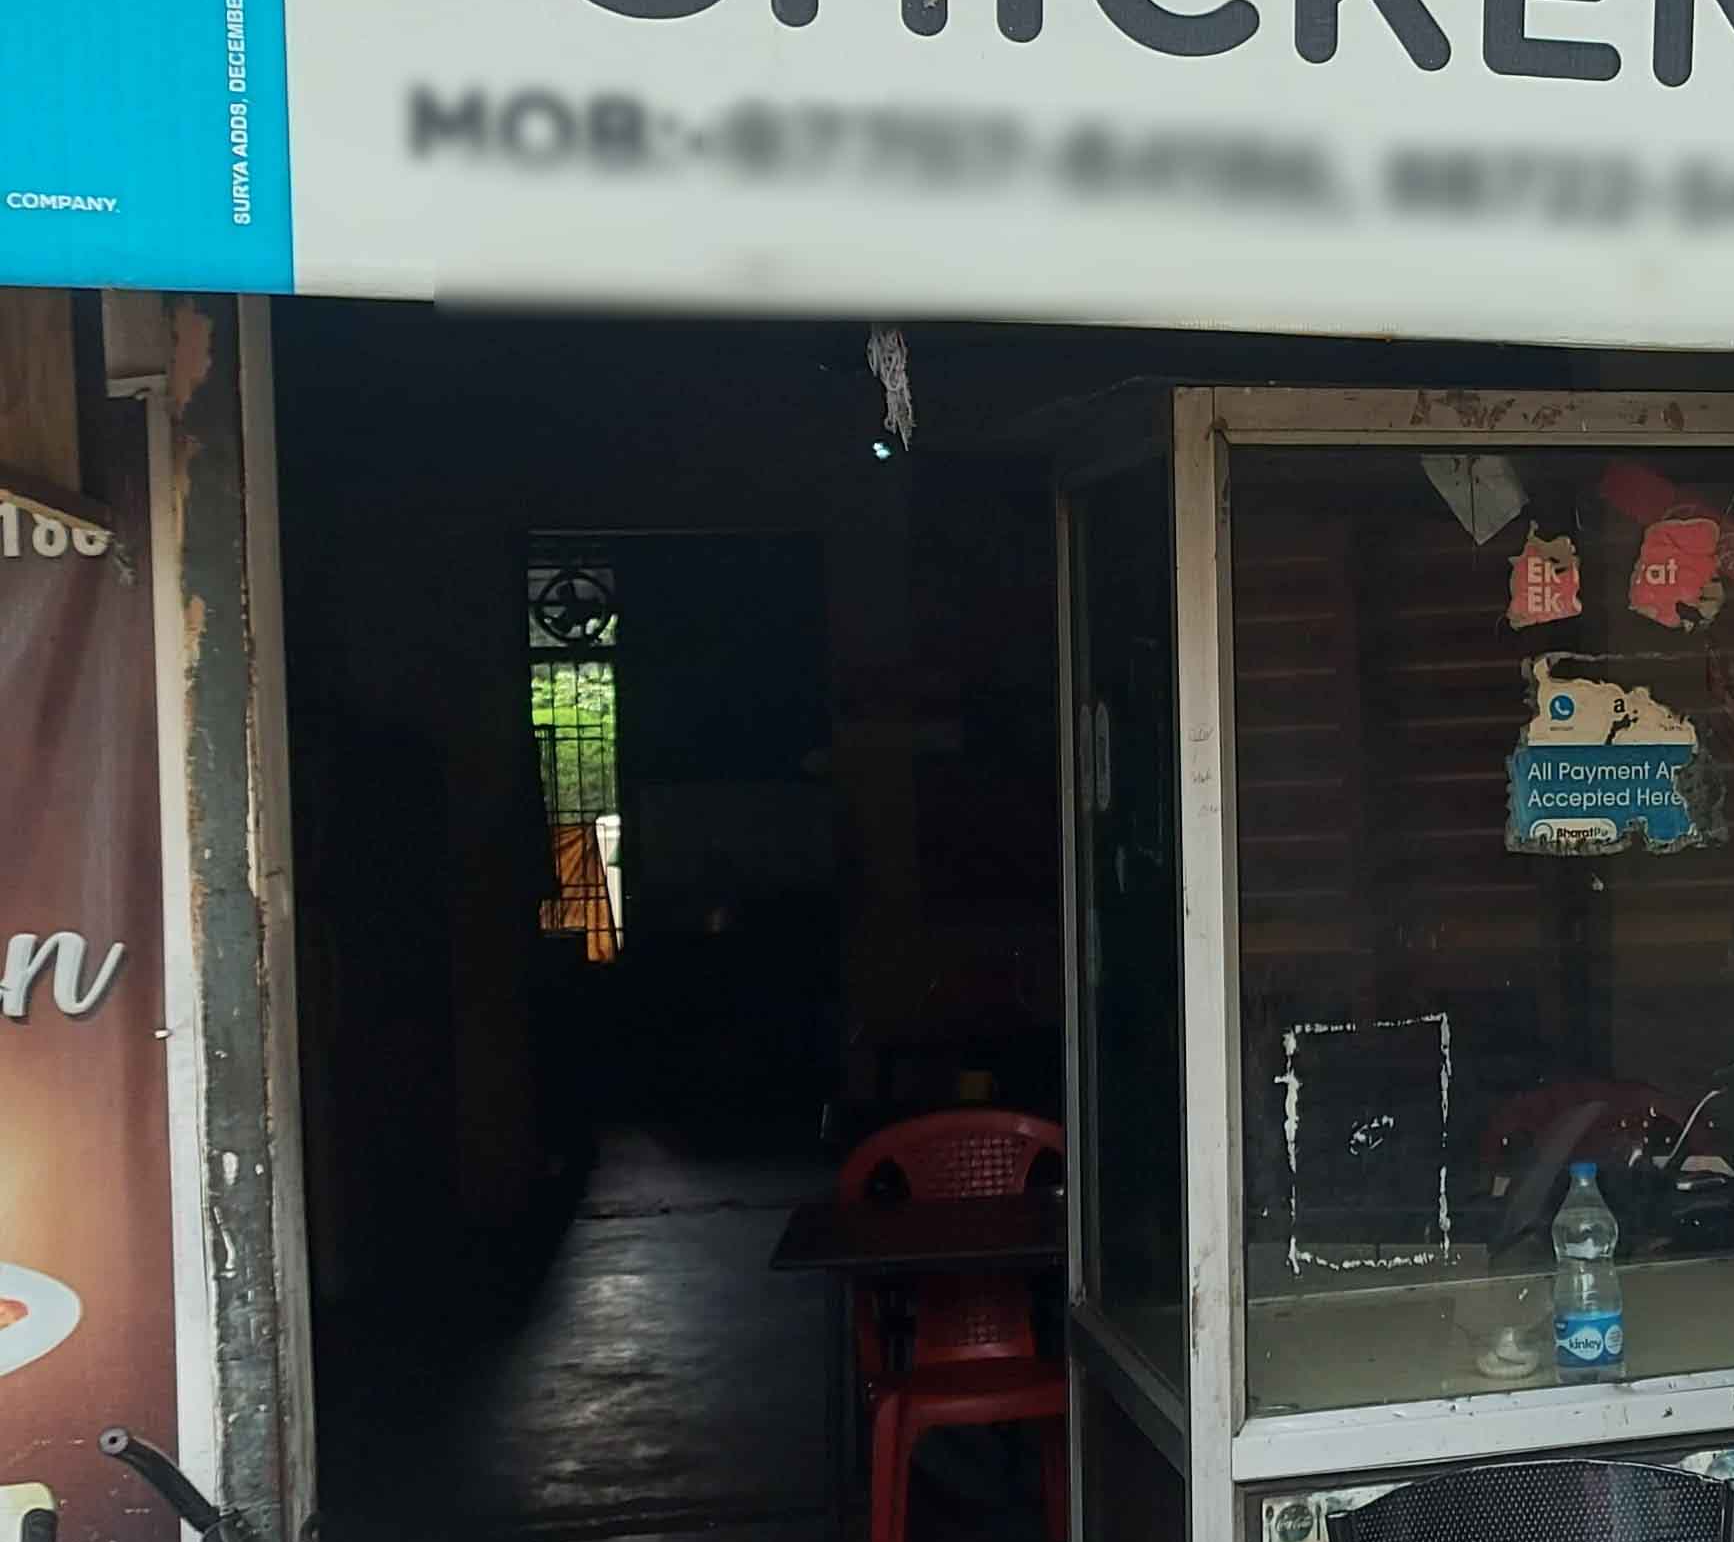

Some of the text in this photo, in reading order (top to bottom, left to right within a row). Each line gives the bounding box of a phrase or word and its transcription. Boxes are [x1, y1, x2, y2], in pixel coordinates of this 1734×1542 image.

[233, 160, 250, 226] SURYA
[1527, 586, 1563, 613] Ek
[1527, 761, 1551, 780] All
[1558, 761, 1650, 786] Payment
[1527, 787, 1681, 812] Accepted Here
